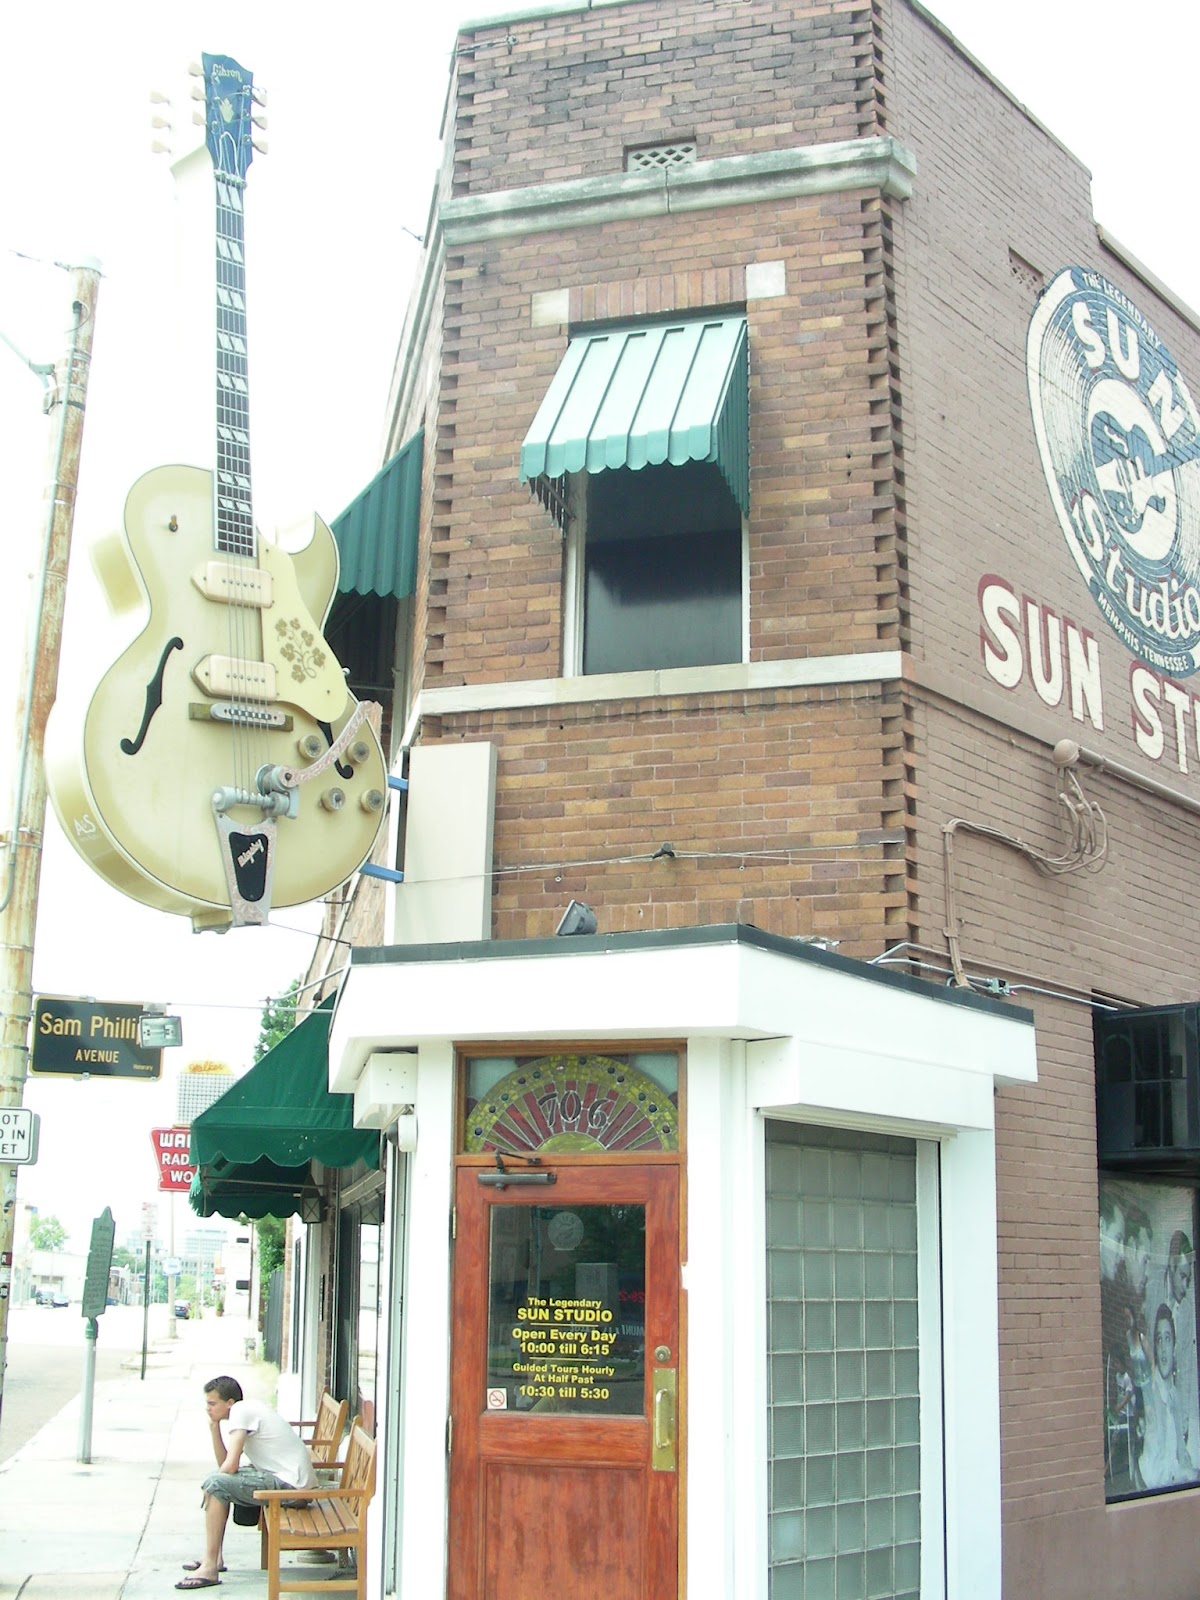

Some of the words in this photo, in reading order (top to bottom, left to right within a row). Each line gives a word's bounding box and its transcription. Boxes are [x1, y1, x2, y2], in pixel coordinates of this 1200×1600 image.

[1082, 272, 1102, 289] THE
[1103, 280, 1162, 349] LEGENDARY
[1071, 301, 1185, 440] SUN
[1071, 491, 1200, 640] Studio
[1142, 645, 1190, 672] TENNESSEE
[978, 574, 1104, 731] SUN
[1129, 661, 1200, 775] ST
[40, 1012, 82, 1036] Sam
[90, 1015, 141, 1045] Philli
[75, 1049, 120, 1063] AVENUE
[537, 1090, 608, 1129] 706
[2, 1114, 19, 1125] OT
[12, 1129, 25, 1140] IN
[159, 1133, 191, 1149] WA
[161, 1152, 190, 1166] RAD
[170, 1170, 194, 1183] WO
[528, 1297, 547, 1306] The
[549, 1298, 602, 1309] Legendary
[517, 1308, 550, 1320] SUN
[554, 1309, 613, 1322] STUDIO
[512, 1328, 546, 1340] Open
[550, 1329, 587, 1343] Every
[591, 1330, 616, 1343] Day
[520, 1342, 556, 1353] 10:00
[559, 1343, 577, 1354] till
[581, 1344, 610, 1355] 6:15
[512, 1363, 548, 1372] Guided
[550, 1364, 579, 1374] Tours
[582, 1365, 615, 1376] Hourly
[534, 1374, 545, 1382] At
[548, 1375, 569, 1383] Half
[571, 1375, 594, 1384] Past
[520, 1385, 555, 1397] 10:30
[559, 1387, 577, 1398] till
[580, 1387, 610, 1399] 5:30
